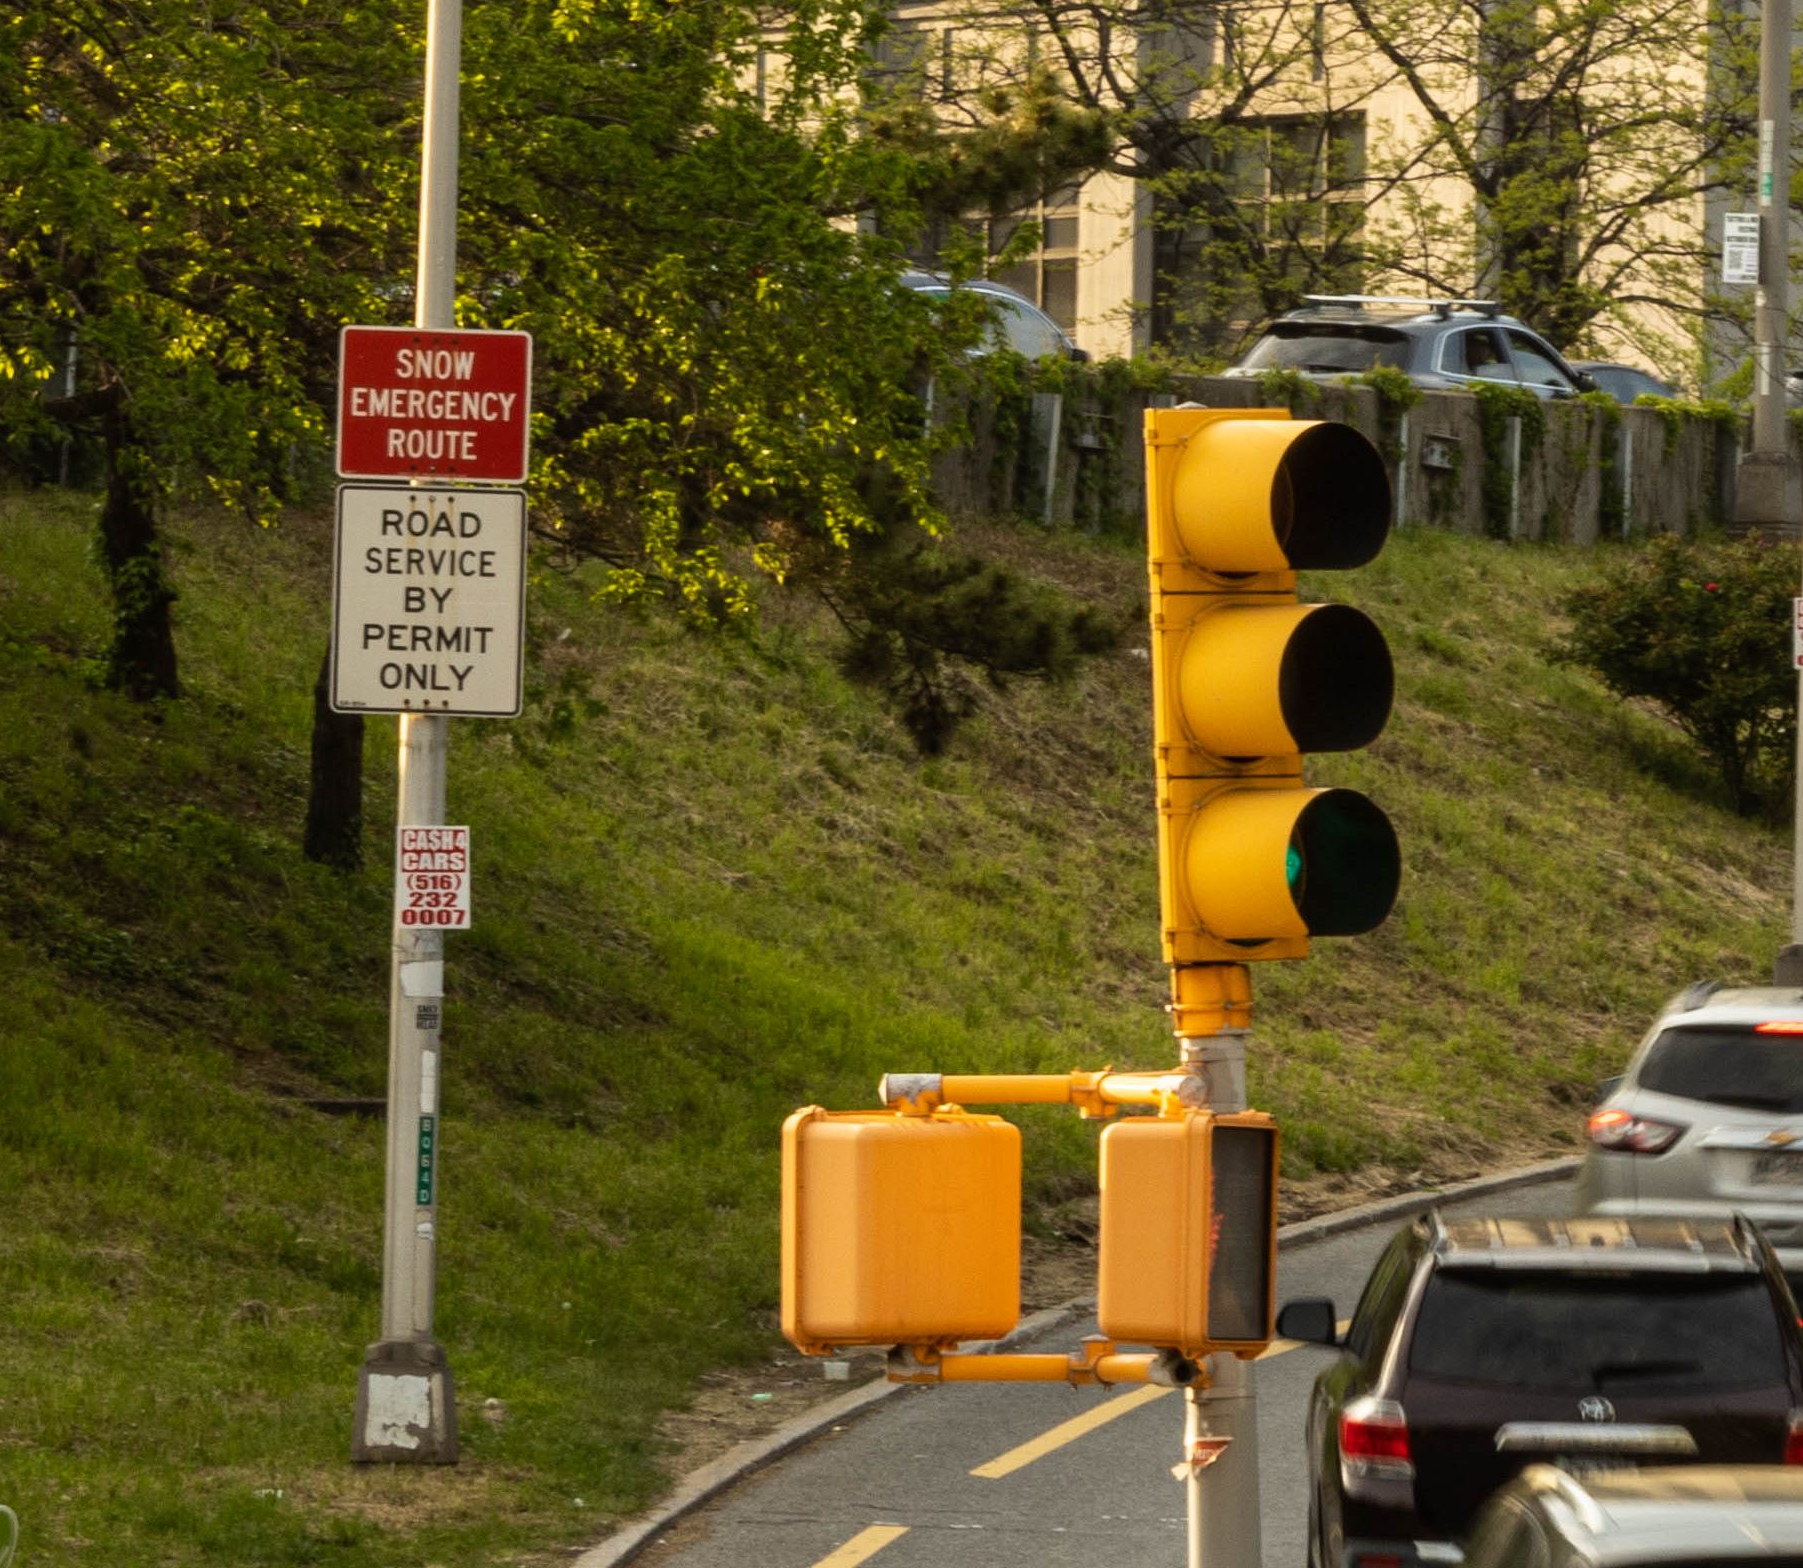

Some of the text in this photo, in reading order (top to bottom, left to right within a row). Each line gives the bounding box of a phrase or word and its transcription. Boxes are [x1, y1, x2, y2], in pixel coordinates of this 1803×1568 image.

[396, 348, 476, 381] SNOW
[350, 387, 517, 423] EMERGENCY
[387, 428, 479, 461] ROUTE
[381, 509, 482, 539] ROAD
[364, 547, 497, 578] SERVICE
[403, 586, 454, 614] BY
[362, 623, 494, 654] PERMIT
[379, 662, 475, 692] ONLY
[402, 851, 465, 871] CARS
[406, 873, 462, 891] (516)
[409, 891, 457, 908] 232
[401, 909, 466, 926] 0007
